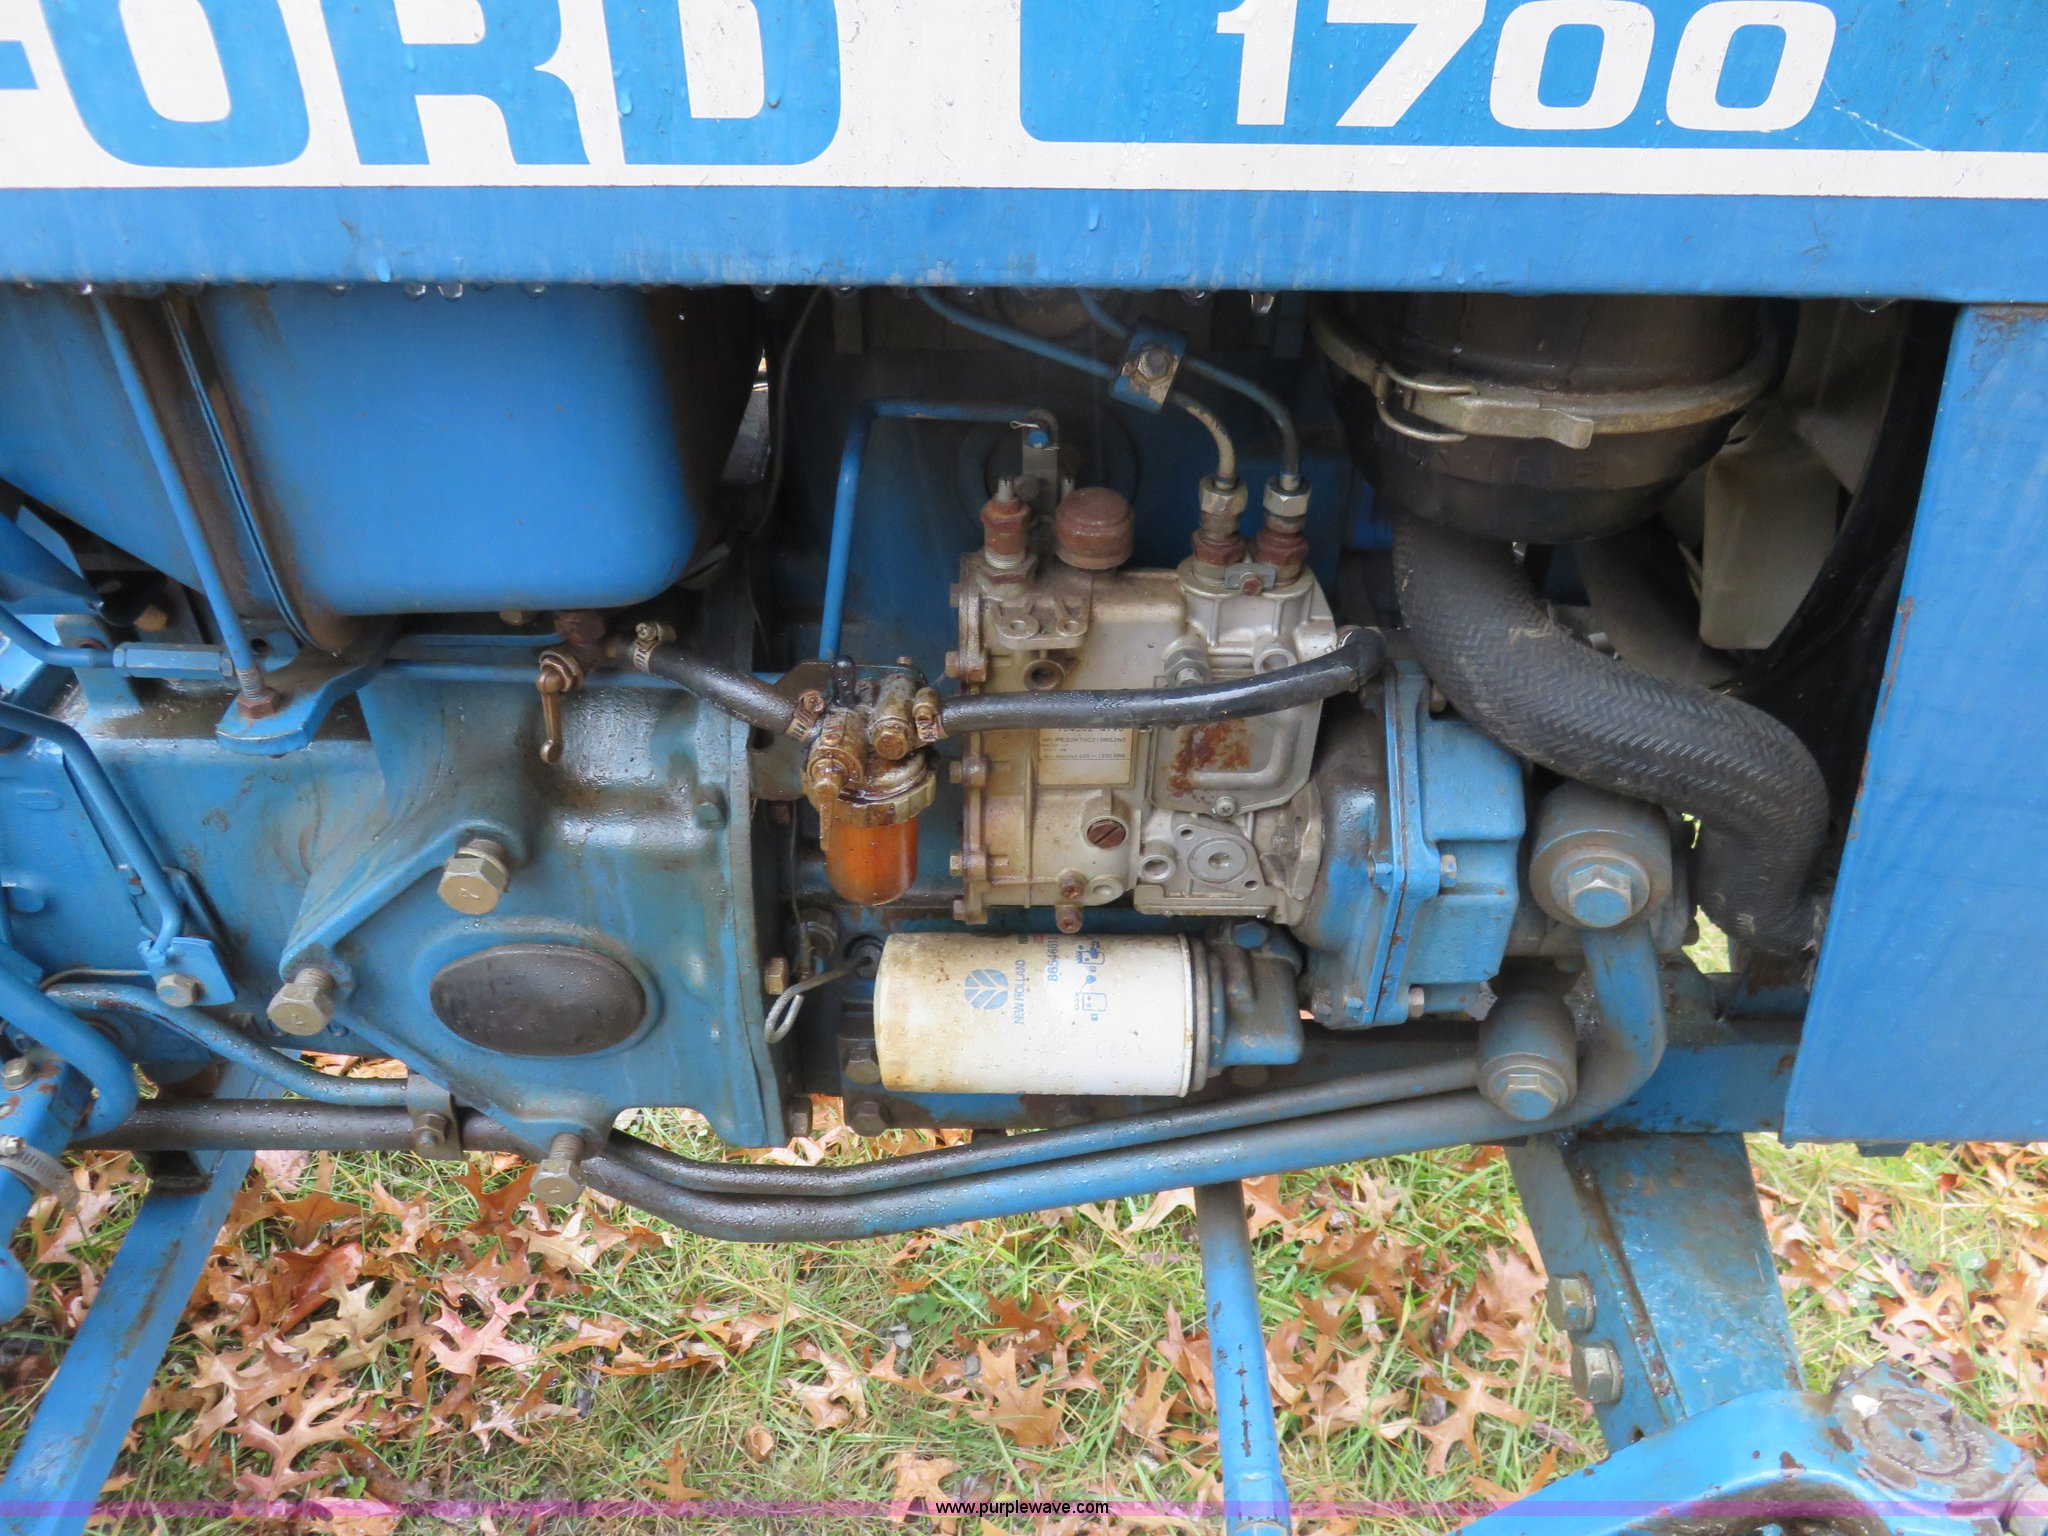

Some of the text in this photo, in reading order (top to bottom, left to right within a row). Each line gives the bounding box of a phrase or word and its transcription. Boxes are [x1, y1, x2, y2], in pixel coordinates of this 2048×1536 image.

[0, 0, 841, 168] ORD
[1217, 0, 1837, 132] 1700
[1014, 960, 1026, 1024] NEW HOLLAND
